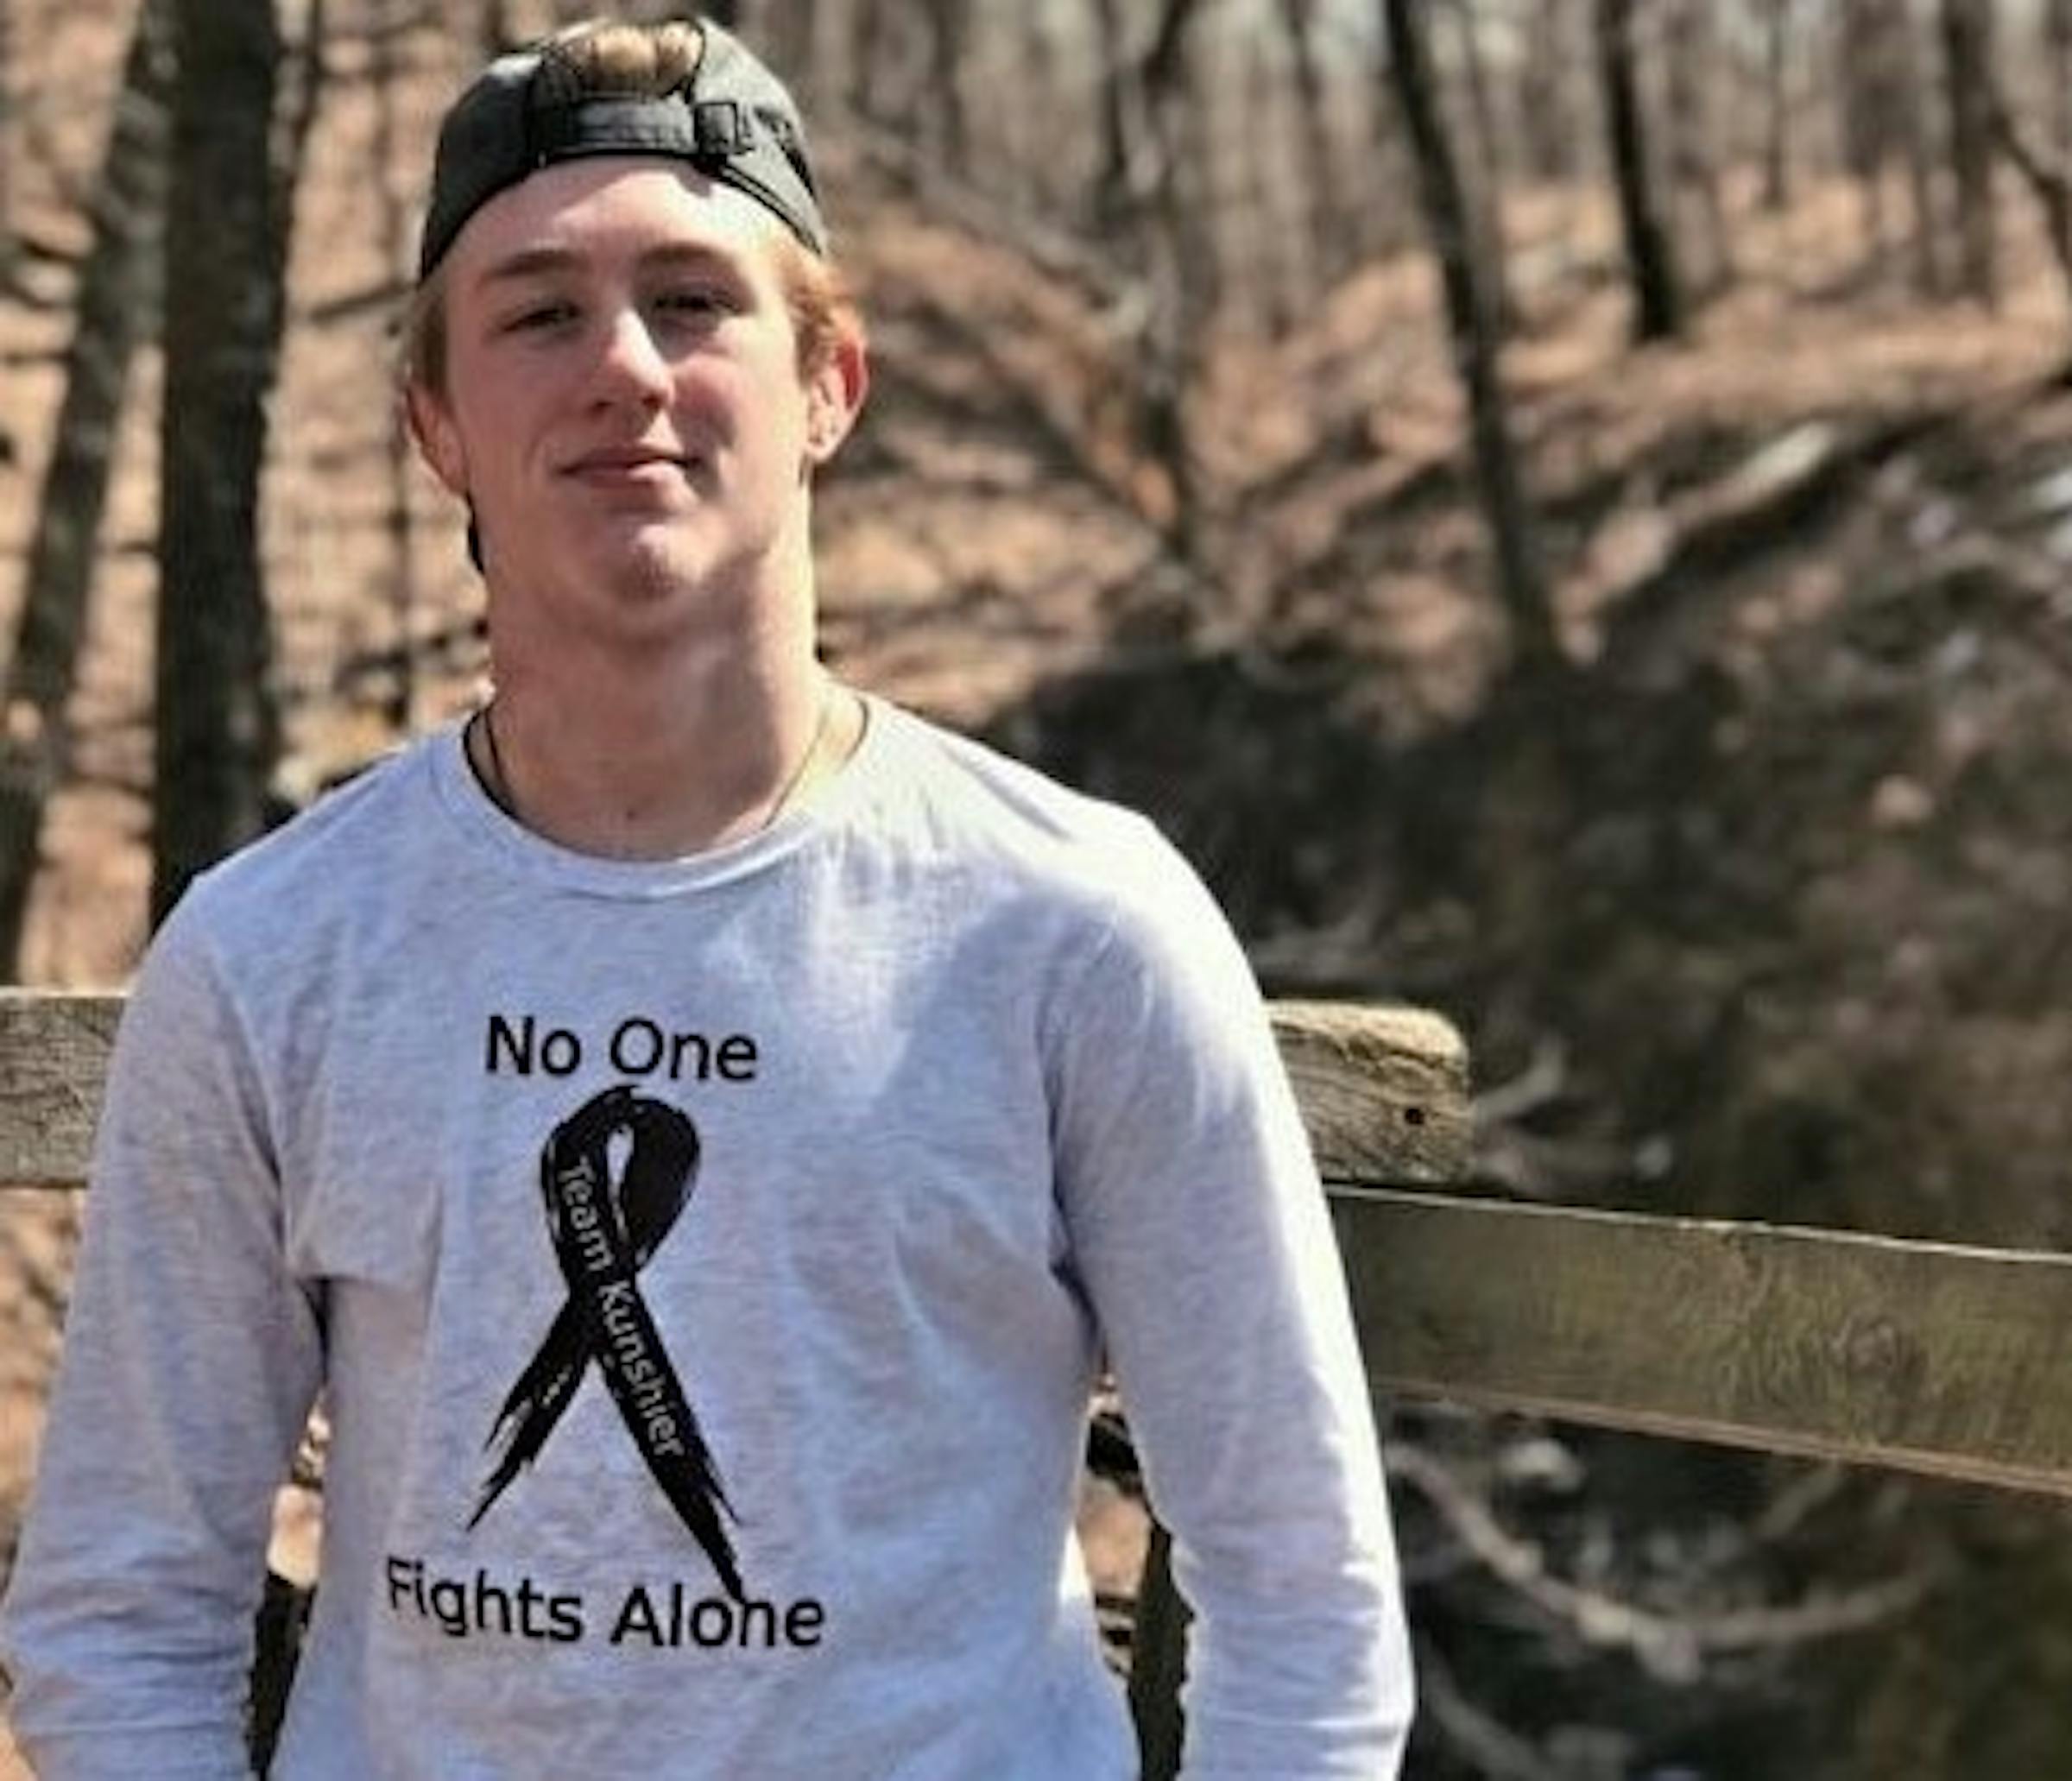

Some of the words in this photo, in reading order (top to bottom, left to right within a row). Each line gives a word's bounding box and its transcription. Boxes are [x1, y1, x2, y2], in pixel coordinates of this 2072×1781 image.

[485, 1014, 582, 1076] No
[610, 1017, 758, 1082] One
[558, 1155, 612, 1272] Team
[386, 1557, 583, 1642] Fights
[610, 1583, 824, 1646] Alone
